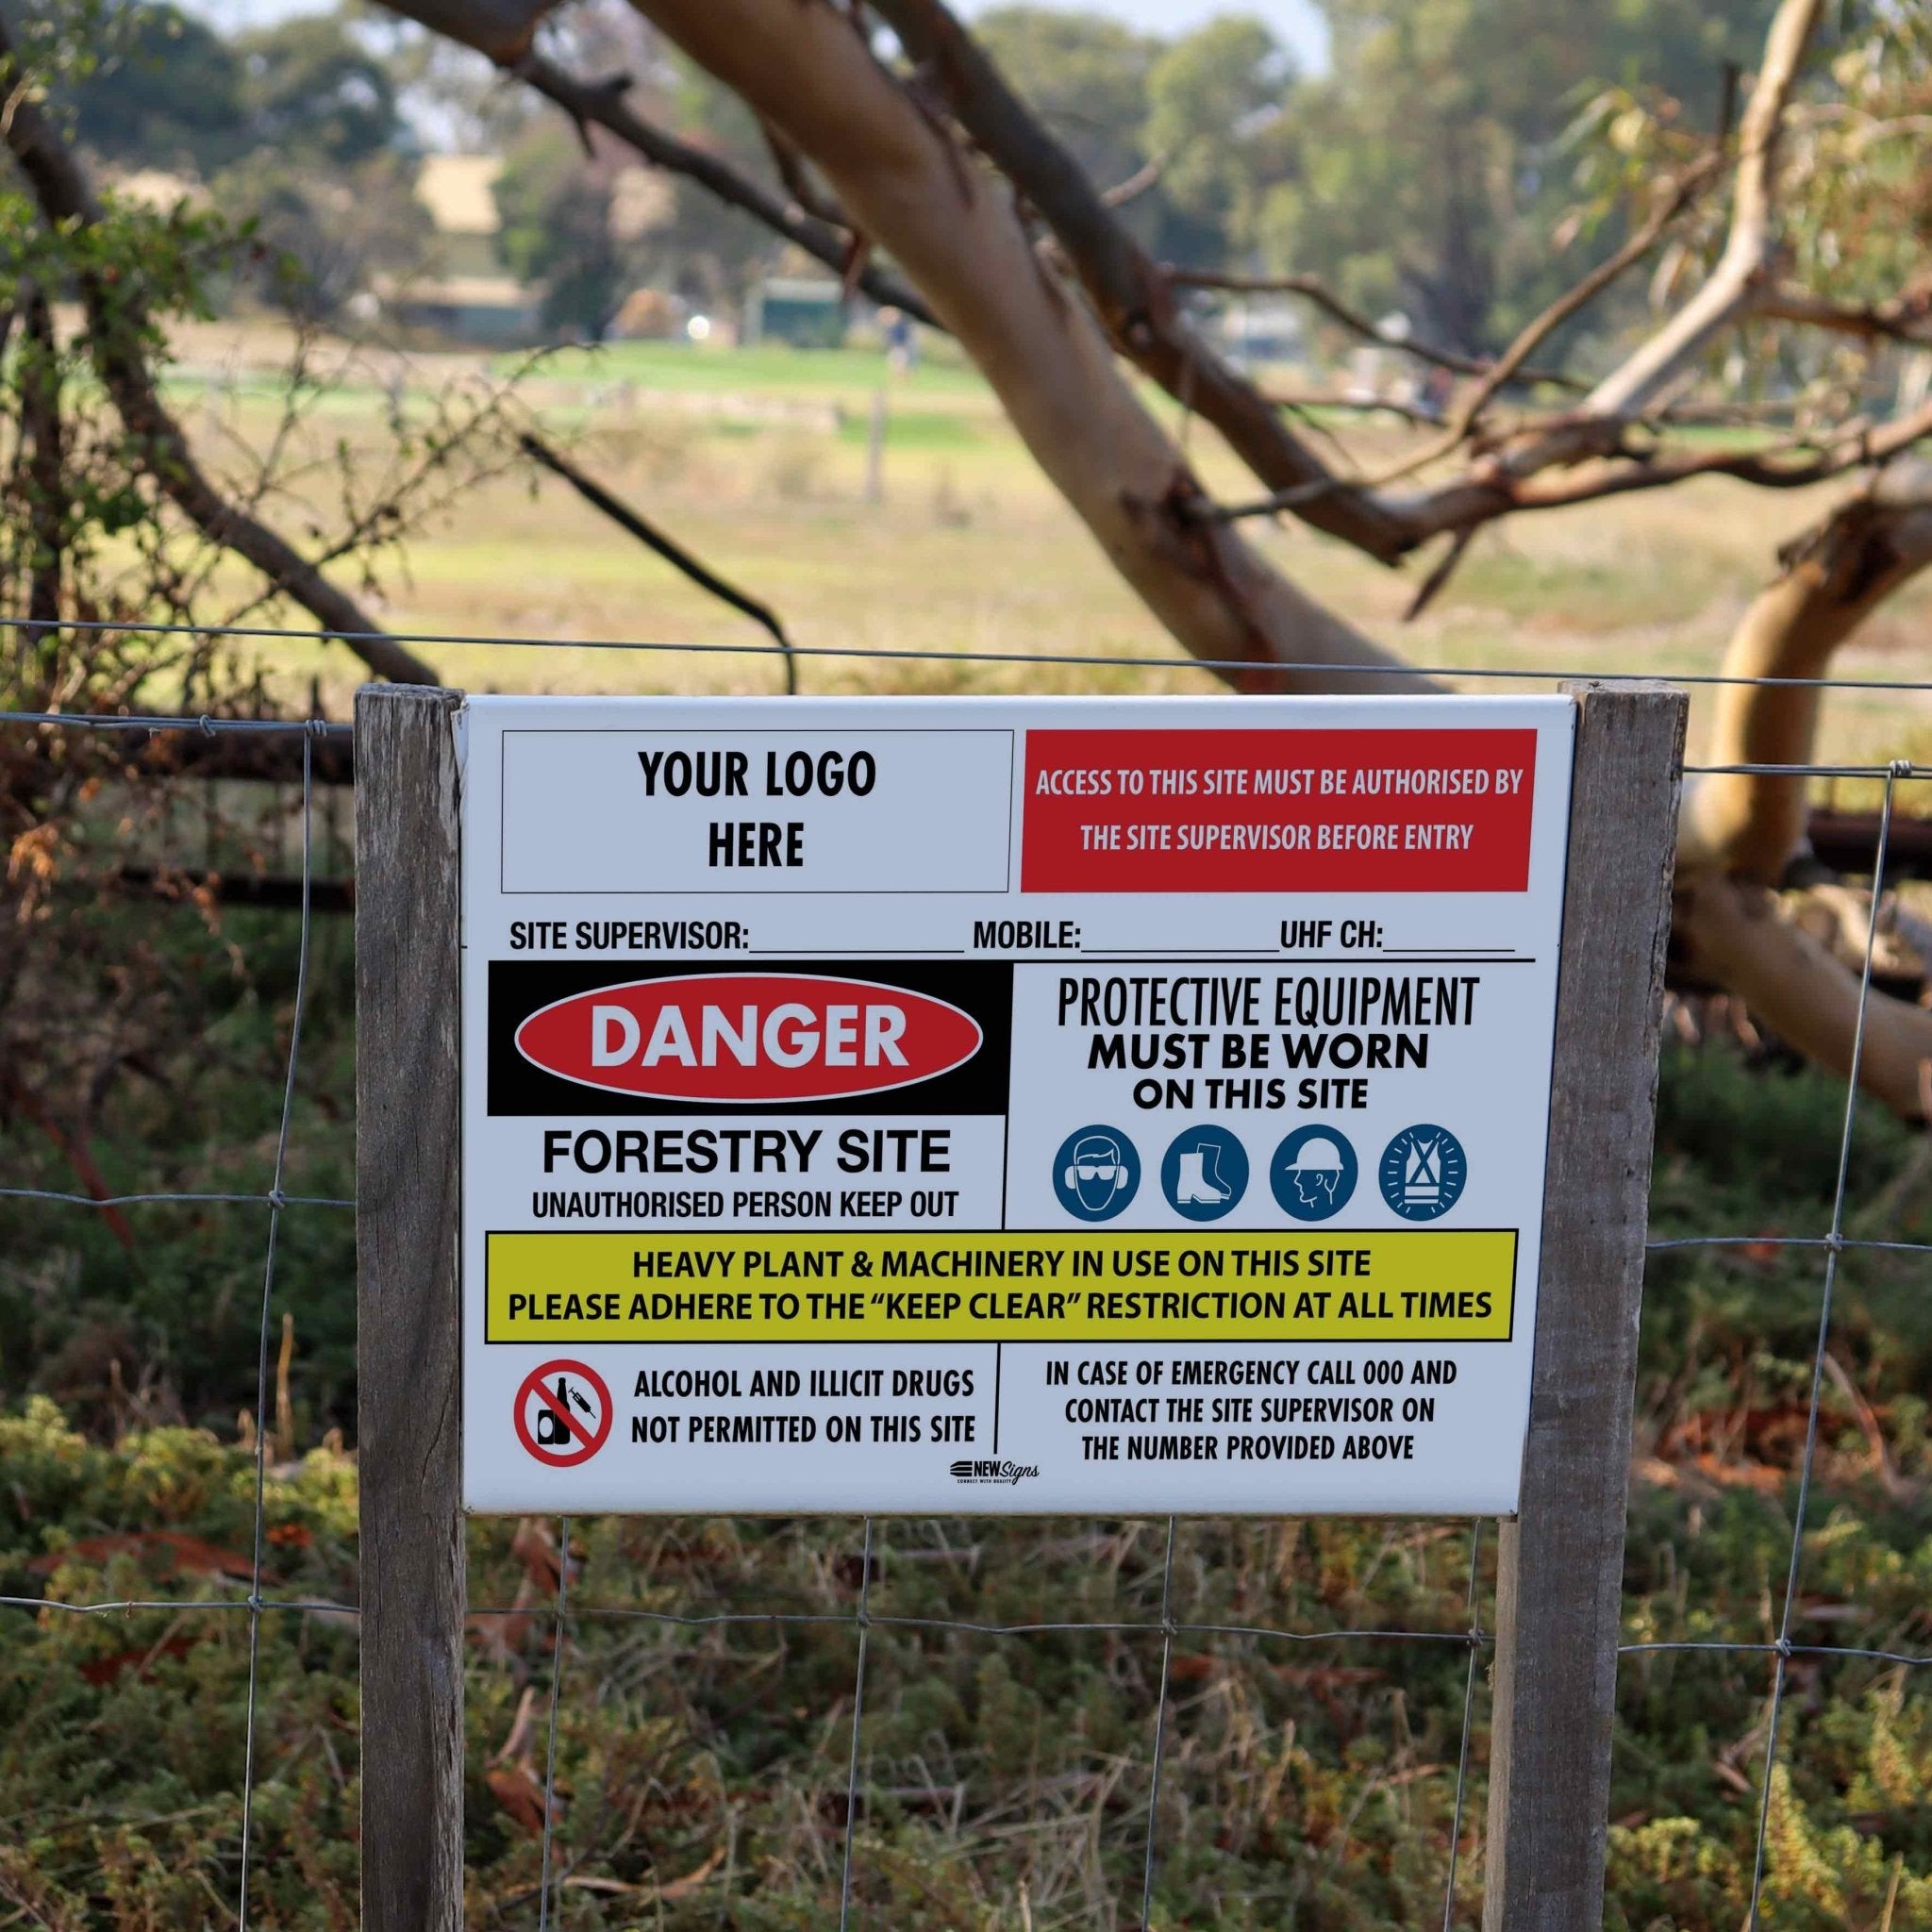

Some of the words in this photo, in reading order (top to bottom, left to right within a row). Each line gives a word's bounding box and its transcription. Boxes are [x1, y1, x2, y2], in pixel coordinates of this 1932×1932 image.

[638, 751, 748, 796] YOUR
[767, 751, 875, 796] LOGO
[1036, 770, 1111, 794] ACCESS
[1118, 770, 1143, 794] TO
[1150, 770, 1197, 794] THIS
[1204, 770, 1247, 794] SITE
[1254, 770, 1314, 794] MUST
[1321, 770, 1346, 793] BE
[1352, 770, 1489, 794] AUTHORISED
[1495, 770, 1523, 793] BY
[709, 823, 804, 866] HERE
[1081, 825, 1121, 849] THE
[1127, 825, 1171, 850] SITE
[1177, 824, 1310, 849] SUPERVISOR
[1318, 824, 1398, 849] BEFORE
[1406, 824, 1474, 849] ENTRY
[510, 922, 567, 949] SITE
[575, 922, 748, 949] SUPERVISOR:
[974, 921, 1080, 948] MOBILE:
[1281, 921, 1332, 948] UHF
[1341, 921, 1382, 948] CH:
[1058, 977, 1260, 1026] PROTECTIVE
[1275, 977, 1480, 1028] EQUIPMENT
[592, 1004, 909, 1068] DANGER
[1088, 1034, 1209, 1069] MUST
[1223, 1034, 1270, 1068] BE
[1282, 1033, 1428, 1069] WORN
[1133, 1079, 1193, 1109] ON
[1206, 1078, 1285, 1108] THIS
[1297, 1078, 1368, 1108] SITE
[544, 1129, 823, 1174] FORESTRY
[838, 1129, 950, 1173] SITE
[533, 1191, 724, 1218] UNAUTHORISED
[734, 1191, 831, 1217] PERSON
[841, 1191, 902, 1216] KEEP
[911, 1191, 958, 1217] OUT
[634, 1252, 735, 1277] HEAVY
[744, 1252, 843, 1276] PLANT
[851, 1251, 873, 1277] &
[882, 1251, 1064, 1276] MACHINERY
[1074, 1251, 1103, 1276] IN
[1113, 1251, 1170, 1276] USE
[1178, 1251, 1224, 1276] ON
[1231, 1250, 1299, 1276] THIS
[1308, 1250, 1371, 1275] SITE
[509, 1294, 620, 1320] PLEASE
[628, 1293, 752, 1319] ADHERE
[759, 1293, 799, 1319] TO
[807, 1293, 864, 1319] THE
[1088, 1292, 1285, 1318] RESTRICTION
[1293, 1292, 1331, 1318] AT
[1339, 1292, 1393, 1318] ALL
[1401, 1292, 1491, 1318] TIMES
[634, 1371, 741, 1397] ALCOHOL
[750, 1371, 800, 1396] AND
[810, 1370, 884, 1396] ILLICIT
[893, 1370, 974, 1396] DRUGS
[1047, 1361, 1068, 1385] IN
[1078, 1361, 1127, 1385] CASE
[1137, 1361, 1163, 1385] OF
[1172, 1360, 1300, 1385] EMERGENCY
[1307, 1360, 1355, 1384] CALL
[1364, 1360, 1403, 1384] 000
[1411, 1360, 1457, 1384] AND
[1066, 1399, 1159, 1423] CONTACT
[1167, 1399, 1203, 1422] THE
[1212, 1398, 1252, 1422] SITE
[1261, 1398, 1393, 1422] SUPERVISOR
[1403, 1398, 1434, 1422] ON
[632, 1416, 680, 1442] NOT
[690, 1416, 816, 1442] PERMITTED
[826, 1416, 860, 1442] ON
[871, 1416, 921, 1442] THIS
[931, 1416, 974, 1441] SITE
[1082, 1437, 1119, 1459] THE
[1128, 1436, 1218, 1459] NUMBER
[1227, 1436, 1334, 1459] PROVIDED
[1342, 1436, 1413, 1459] ABOVE
